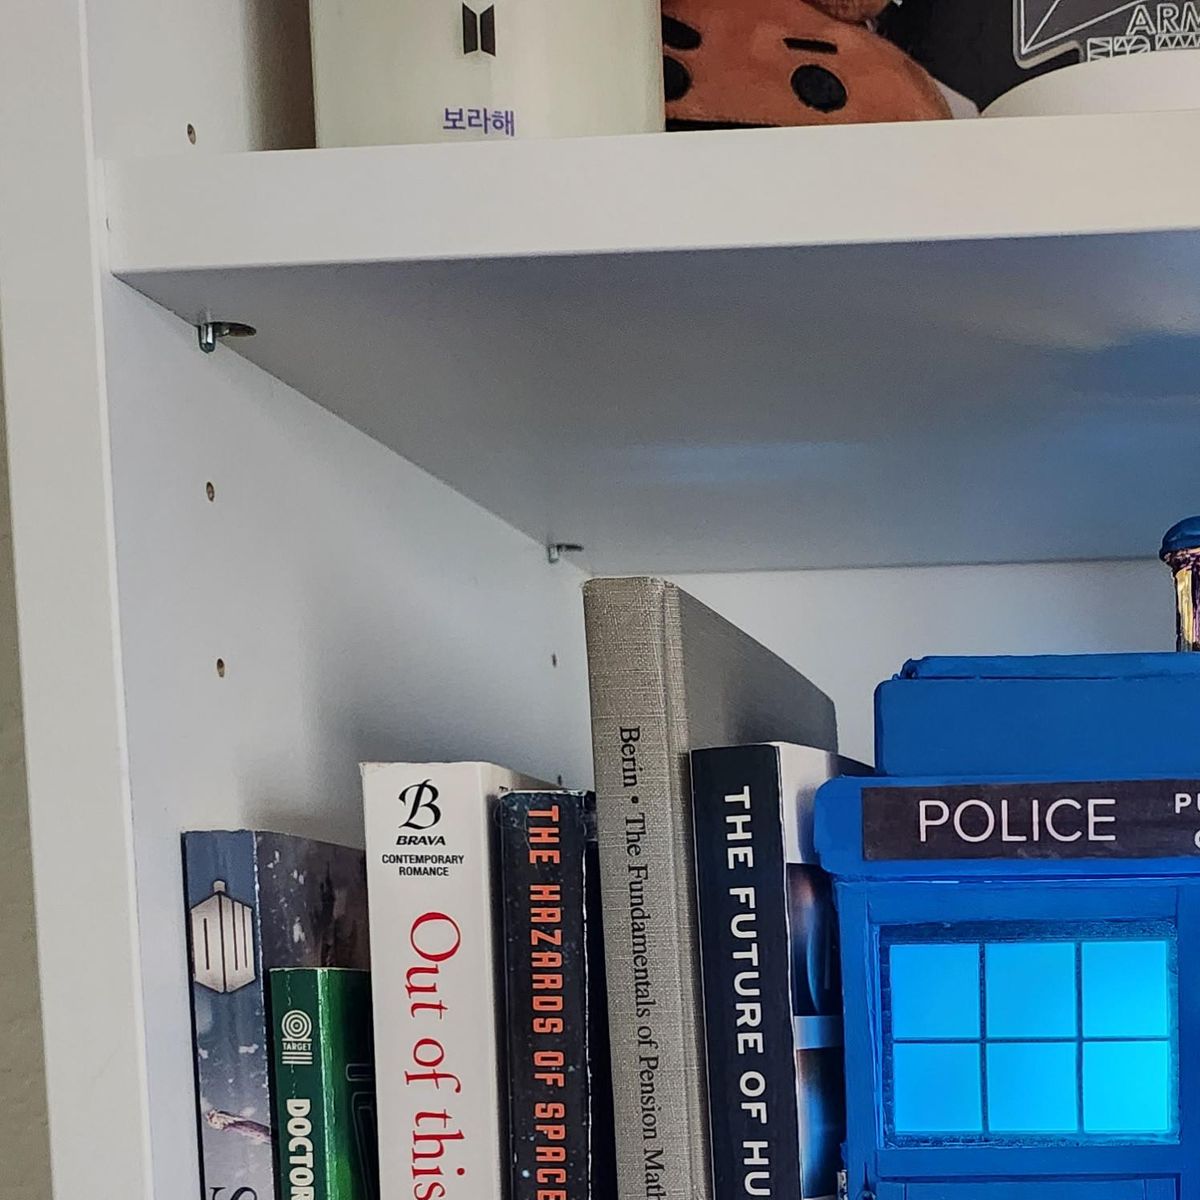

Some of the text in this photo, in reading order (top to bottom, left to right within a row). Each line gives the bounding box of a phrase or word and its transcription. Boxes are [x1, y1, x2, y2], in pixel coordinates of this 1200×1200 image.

[442, 107, 516, 137] 보라해
[619, 726, 644, 787] Berin
[396, 835, 446, 846] BRAVA
[527, 805, 561, 864] THE
[625, 813, 648, 857] The
[723, 785, 755, 869] THE
[918, 798, 1117, 842] POLICE
[381, 854, 465, 865] CONTEMPORARY
[398, 866, 450, 876] ROMANCE
[406, 911, 462, 1020] Out
[530, 885, 564, 1036] HAZARDS
[628, 864, 658, 1018] Fundamentals
[730, 886, 765, 1055] FUTURE
[282, 1040, 312, 1052] TARGET
[637, 1025, 659, 1050] of
[405, 1037, 462, 1095] of
[533, 1051, 565, 1087] OF
[639, 1055, 662, 1140] Pension
[739, 1070, 768, 1125] OF
